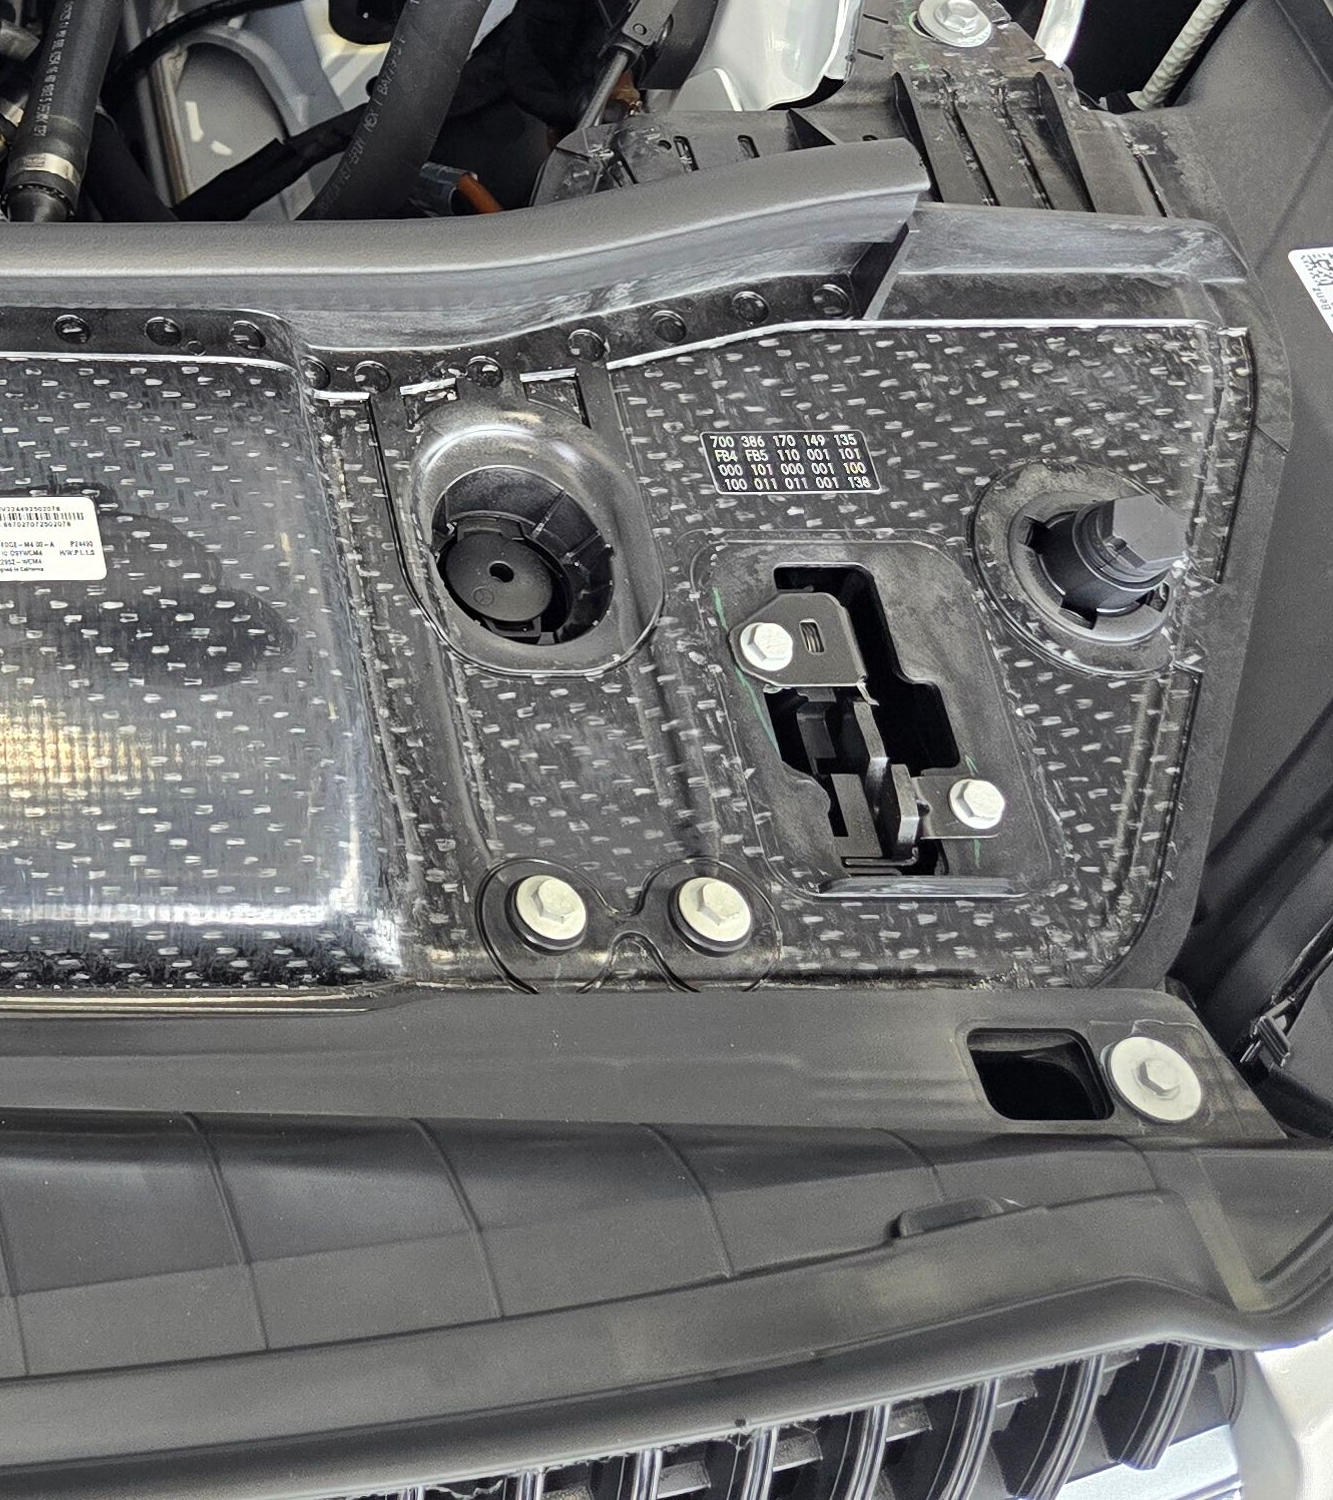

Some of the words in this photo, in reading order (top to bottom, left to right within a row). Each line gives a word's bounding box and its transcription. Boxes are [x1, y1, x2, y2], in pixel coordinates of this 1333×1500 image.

[710, 436, 734, 448] 700
[773, 436, 795, 447] 170
[803, 435, 825, 446] 149
[834, 434, 856, 446] 135
[715, 450, 737, 462] FB4
[745, 450, 768, 462] FB5
[777, 450, 800, 461] 110
[807, 449, 831, 460] 001
[839, 448, 861, 460] 101
[718, 464, 743, 476] 000
[751, 464, 773, 476] 101
[781, 464, 804, 475] 000
[812, 463, 835, 474] 001
[843, 462, 866, 474] 100
[725, 478, 747, 490] 100
[754, 478, 777, 490] 011
[785, 478, 808, 490] 011
[816, 477, 839, 489] 001
